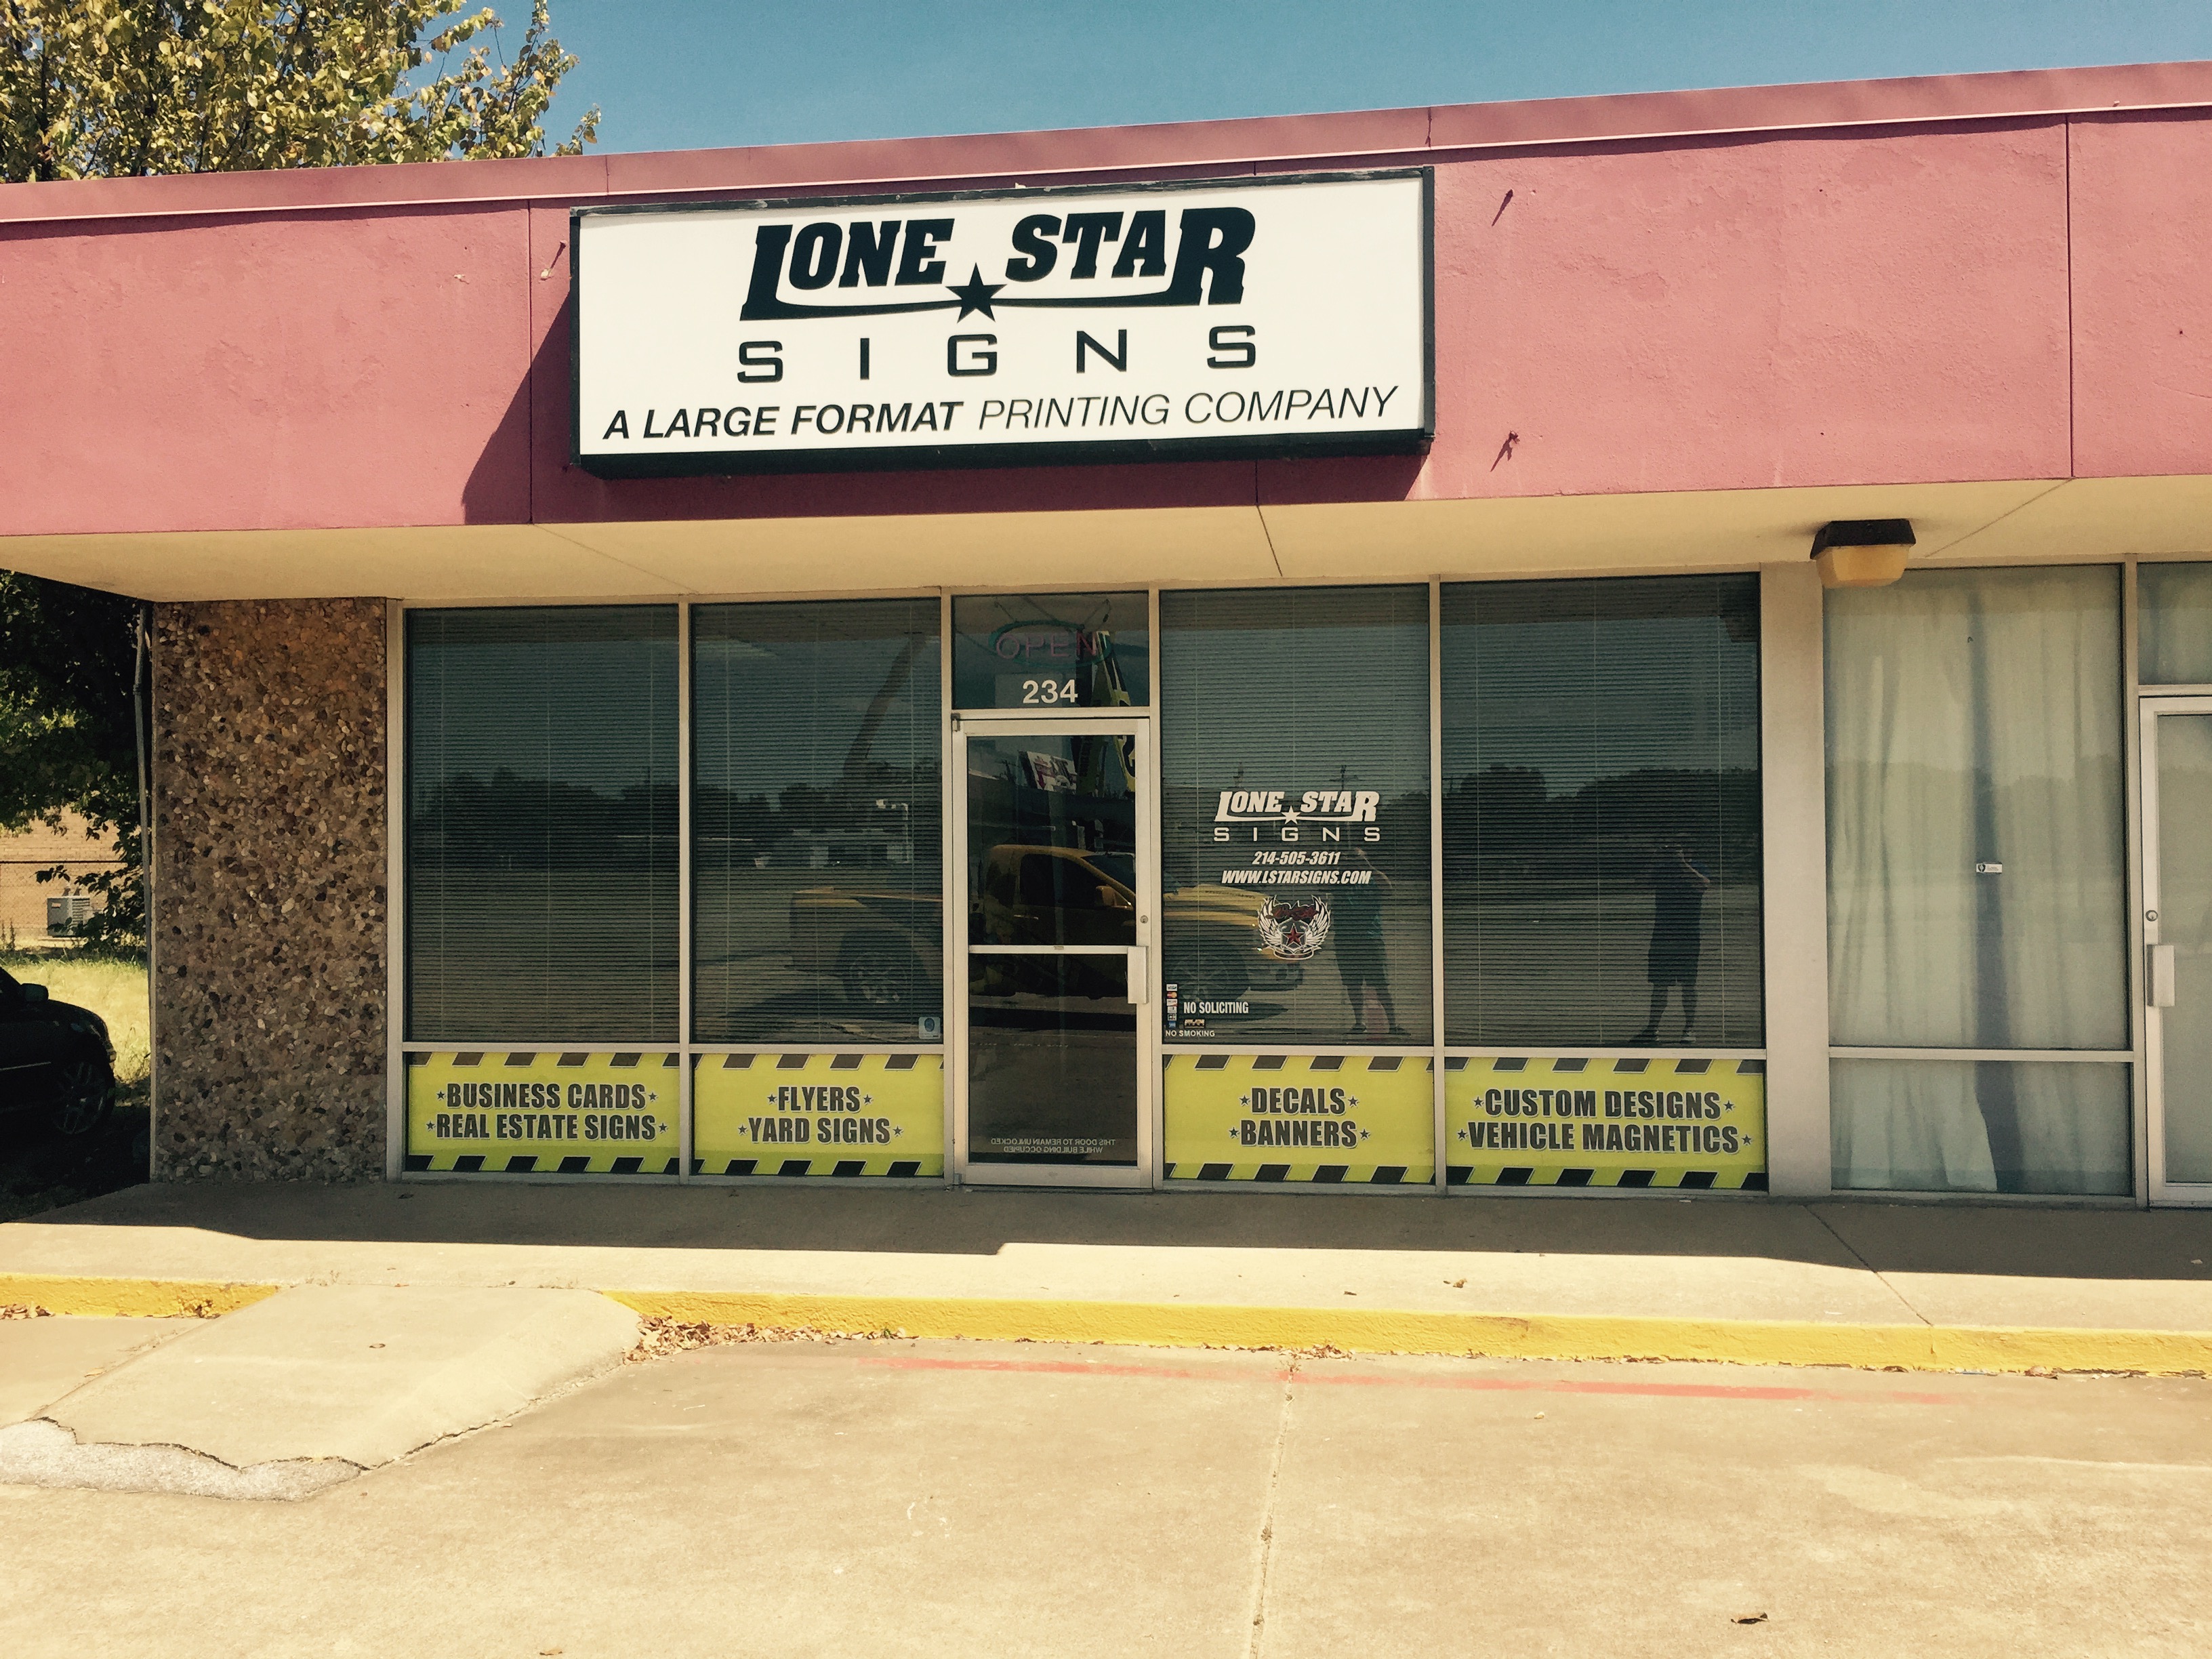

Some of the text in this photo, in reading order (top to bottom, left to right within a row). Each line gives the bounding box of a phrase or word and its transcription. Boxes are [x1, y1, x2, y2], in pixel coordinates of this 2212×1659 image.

[739, 207, 1256, 321] LONE STAR
[737, 325, 1256, 384] SIGNS
[602, 386, 1399, 440] A LARGE FORMAT PRINTING COMPANY
[996, 630, 1098, 660] OPEN
[1023, 679, 1078, 703] 234
[1214, 791, 1380, 822] LONE STAR
[1213, 827, 1380, 842] SIGNS
[1252, 851, 1341, 865] 214-505-3611
[1221, 870, 1372, 884] WWW.LSTARSIGNS.COM
[1183, 1001, 1249, 1015] NO SOLICITING
[1179, 1029, 1215, 1038] SMOKING
[447, 1083, 646, 1110] BUSINESS CARDS
[778, 1086, 861, 1112] FLYERS
[1251, 1087, 1346, 1114] DECALS
[1485, 1088, 1721, 1119] CUSTOM DESIGNS
[436, 1113, 657, 1141] REAL ESTATE SIGNS
[748, 1118, 891, 1144] YARD SIGNS
[1241, 1120, 1357, 1147] BANNERS
[1468, 1122, 1739, 1153] VEHICLE MAGNETICS
